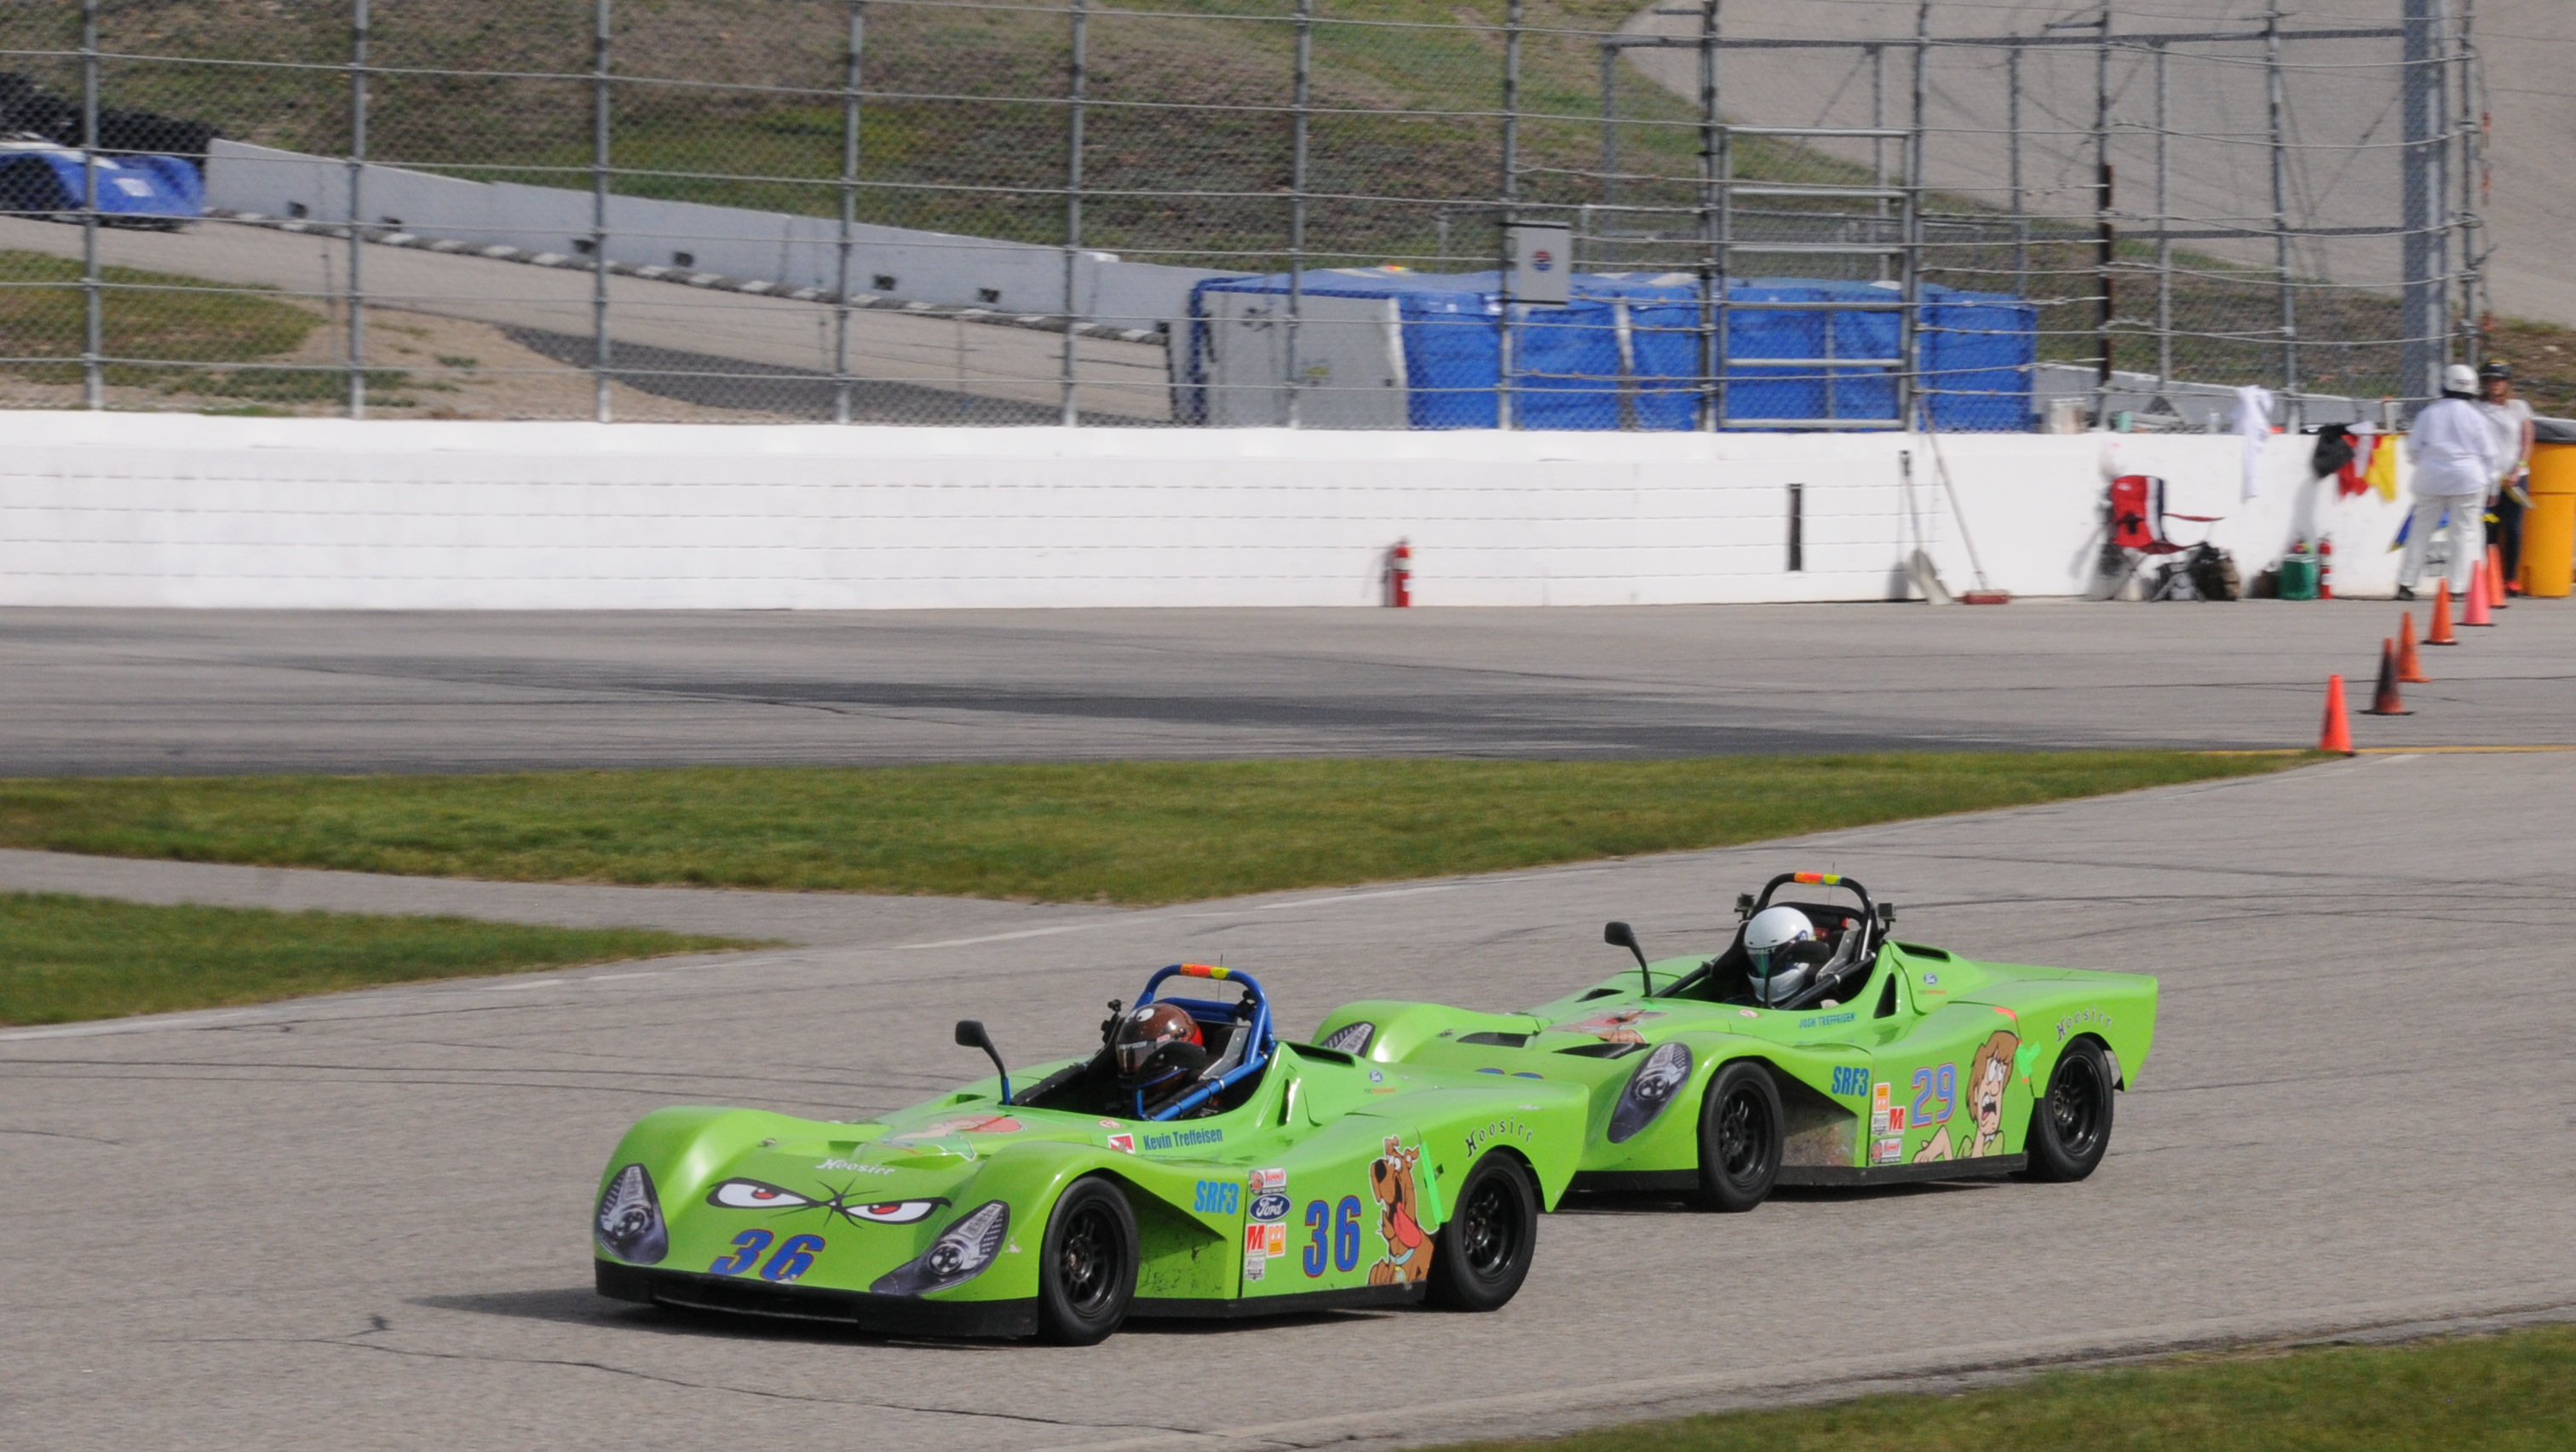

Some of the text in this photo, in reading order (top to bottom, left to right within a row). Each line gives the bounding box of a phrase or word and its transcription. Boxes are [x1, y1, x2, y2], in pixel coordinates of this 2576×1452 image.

[1831, 1065, 1871, 1098] SRF3
[1910, 1062, 1957, 1129] 29
[1142, 1127, 1223, 1150] Kevin Treffeisen
[1193, 1179, 1240, 1216] SRF3
[1256, 1196, 1285, 1217] Ford
[708, 1228, 826, 1282] 36
[1302, 1195, 1362, 1278] 36
